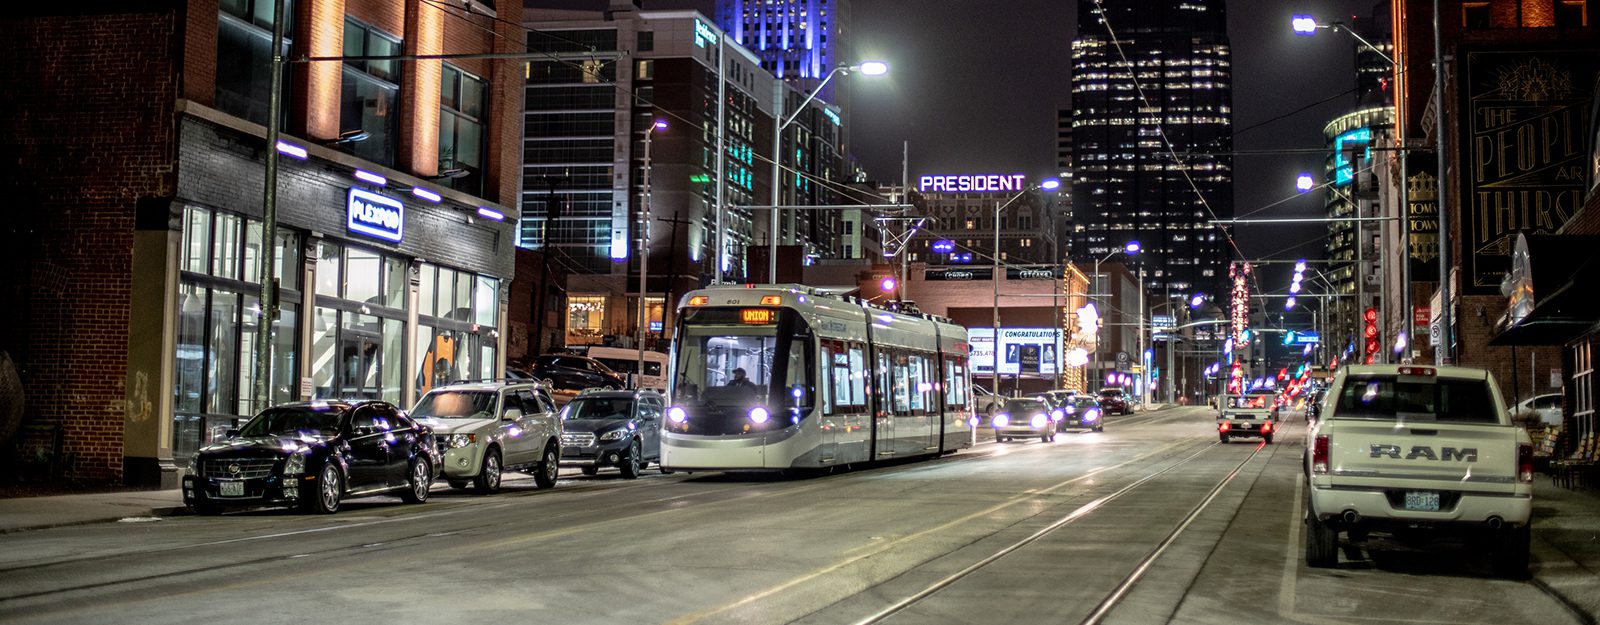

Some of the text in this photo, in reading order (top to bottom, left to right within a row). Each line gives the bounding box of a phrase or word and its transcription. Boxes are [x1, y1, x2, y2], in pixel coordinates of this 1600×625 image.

[695, 17, 717, 45] Residence
[1478, 106, 1517, 129] THE
[920, 174, 1025, 192] PRESIDENT
[1555, 166, 1584, 182] AR
[353, 199, 400, 229] PLEXPOD
[1410, 219, 1438, 231] TOWN
[744, 309, 769, 321] UNION
[1370, 444, 1478, 463] RAM
